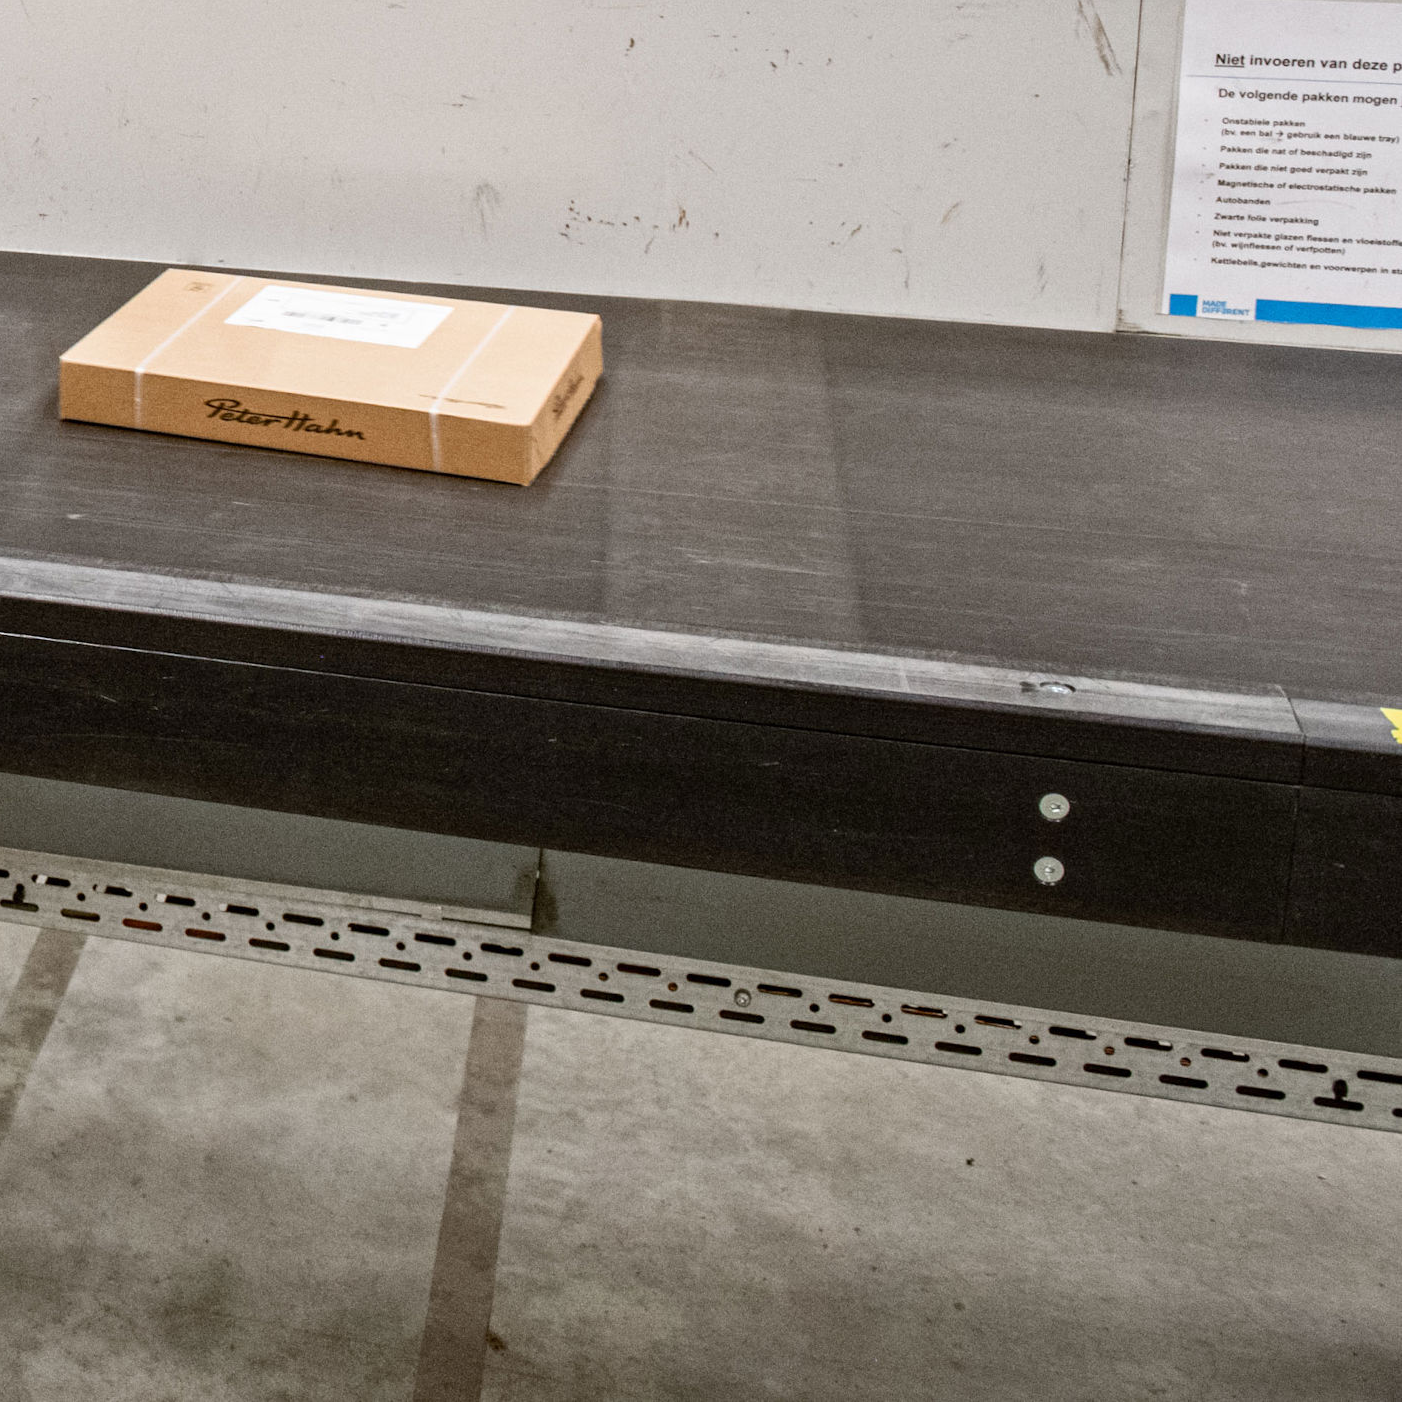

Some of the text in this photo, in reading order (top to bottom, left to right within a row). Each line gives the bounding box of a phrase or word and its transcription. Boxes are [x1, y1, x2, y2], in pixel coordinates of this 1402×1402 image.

[1214, 53, 1245, 67] Niet
[1249, 55, 1315, 68] invoeren
[1320, 59, 1347, 69] van
[1352, 59, 1388, 70] deze
[1218, 88, 1398, 107] De volgende pakken mogen
[1273, 119, 1306, 128] pakken
[1220, 145, 1253, 155] Pakken
[1219, 162, 1252, 172] Pakken
